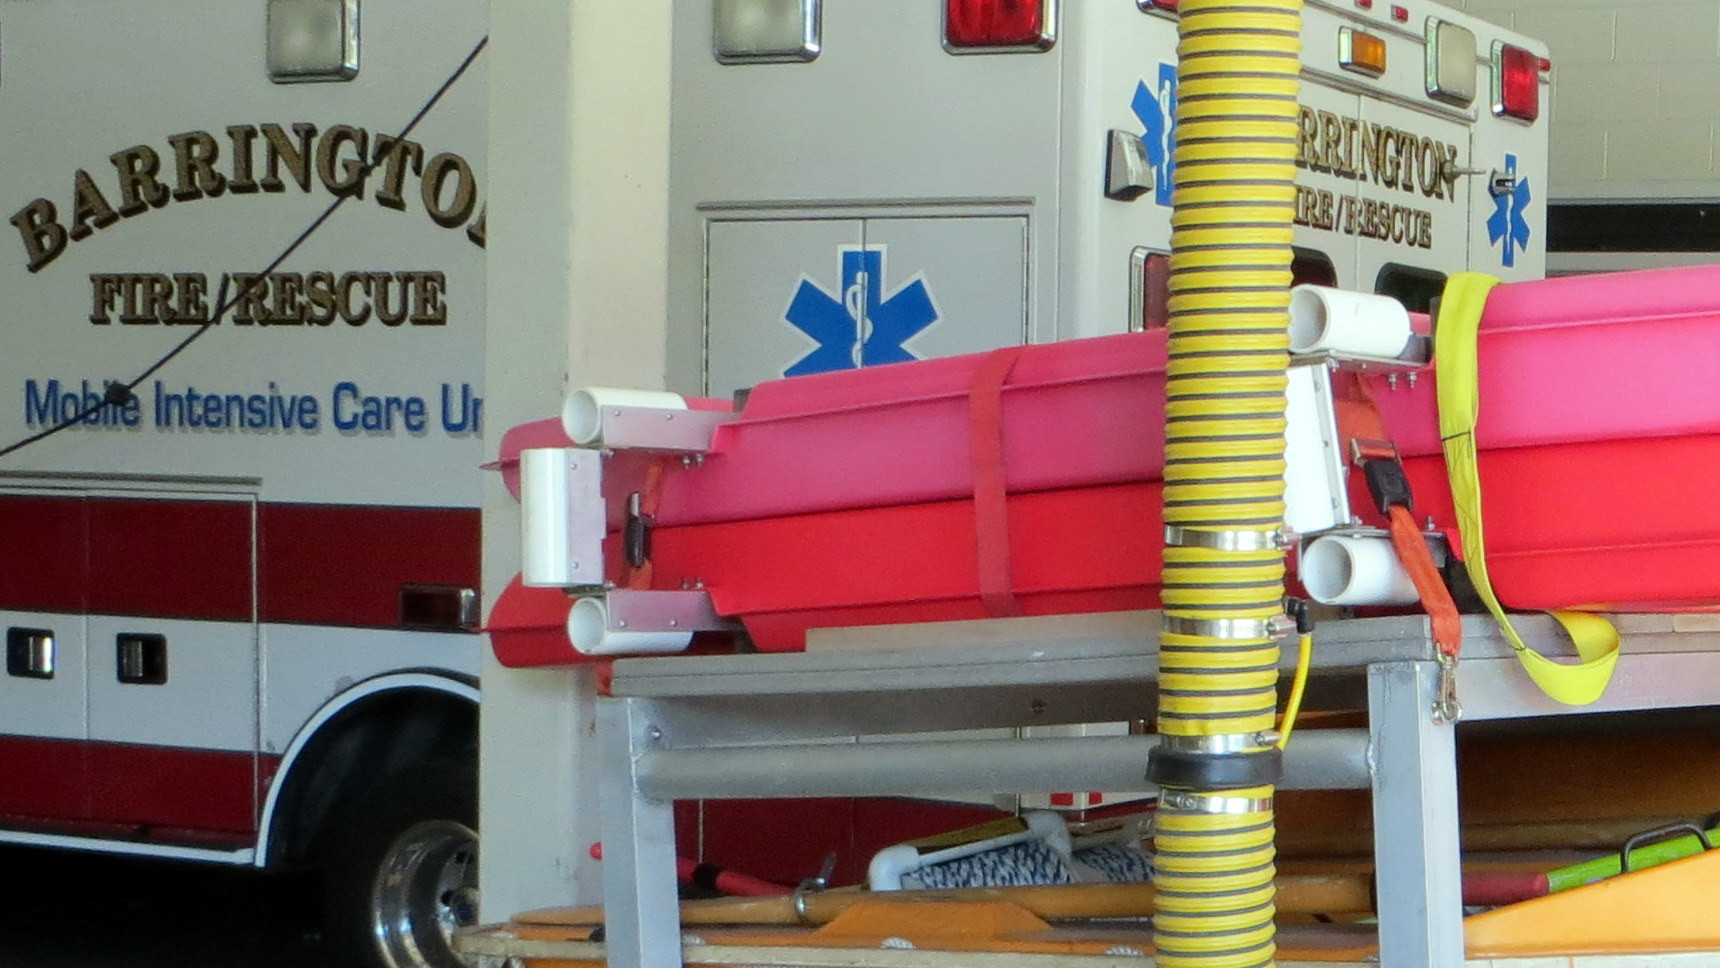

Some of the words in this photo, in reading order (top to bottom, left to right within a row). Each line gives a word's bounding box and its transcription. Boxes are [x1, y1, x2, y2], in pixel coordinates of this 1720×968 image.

[1295, 104, 1458, 204] RRINGTON
[9, 122, 486, 273] BARRINGTO
[1292, 183, 1433, 250] IRE/RESCUE
[88, 270, 447, 327] FIRE/RESCUE
[24, 378, 142, 430] Mobile
[154, 380, 319, 433] Intensive
[331, 380, 427, 434] Care
